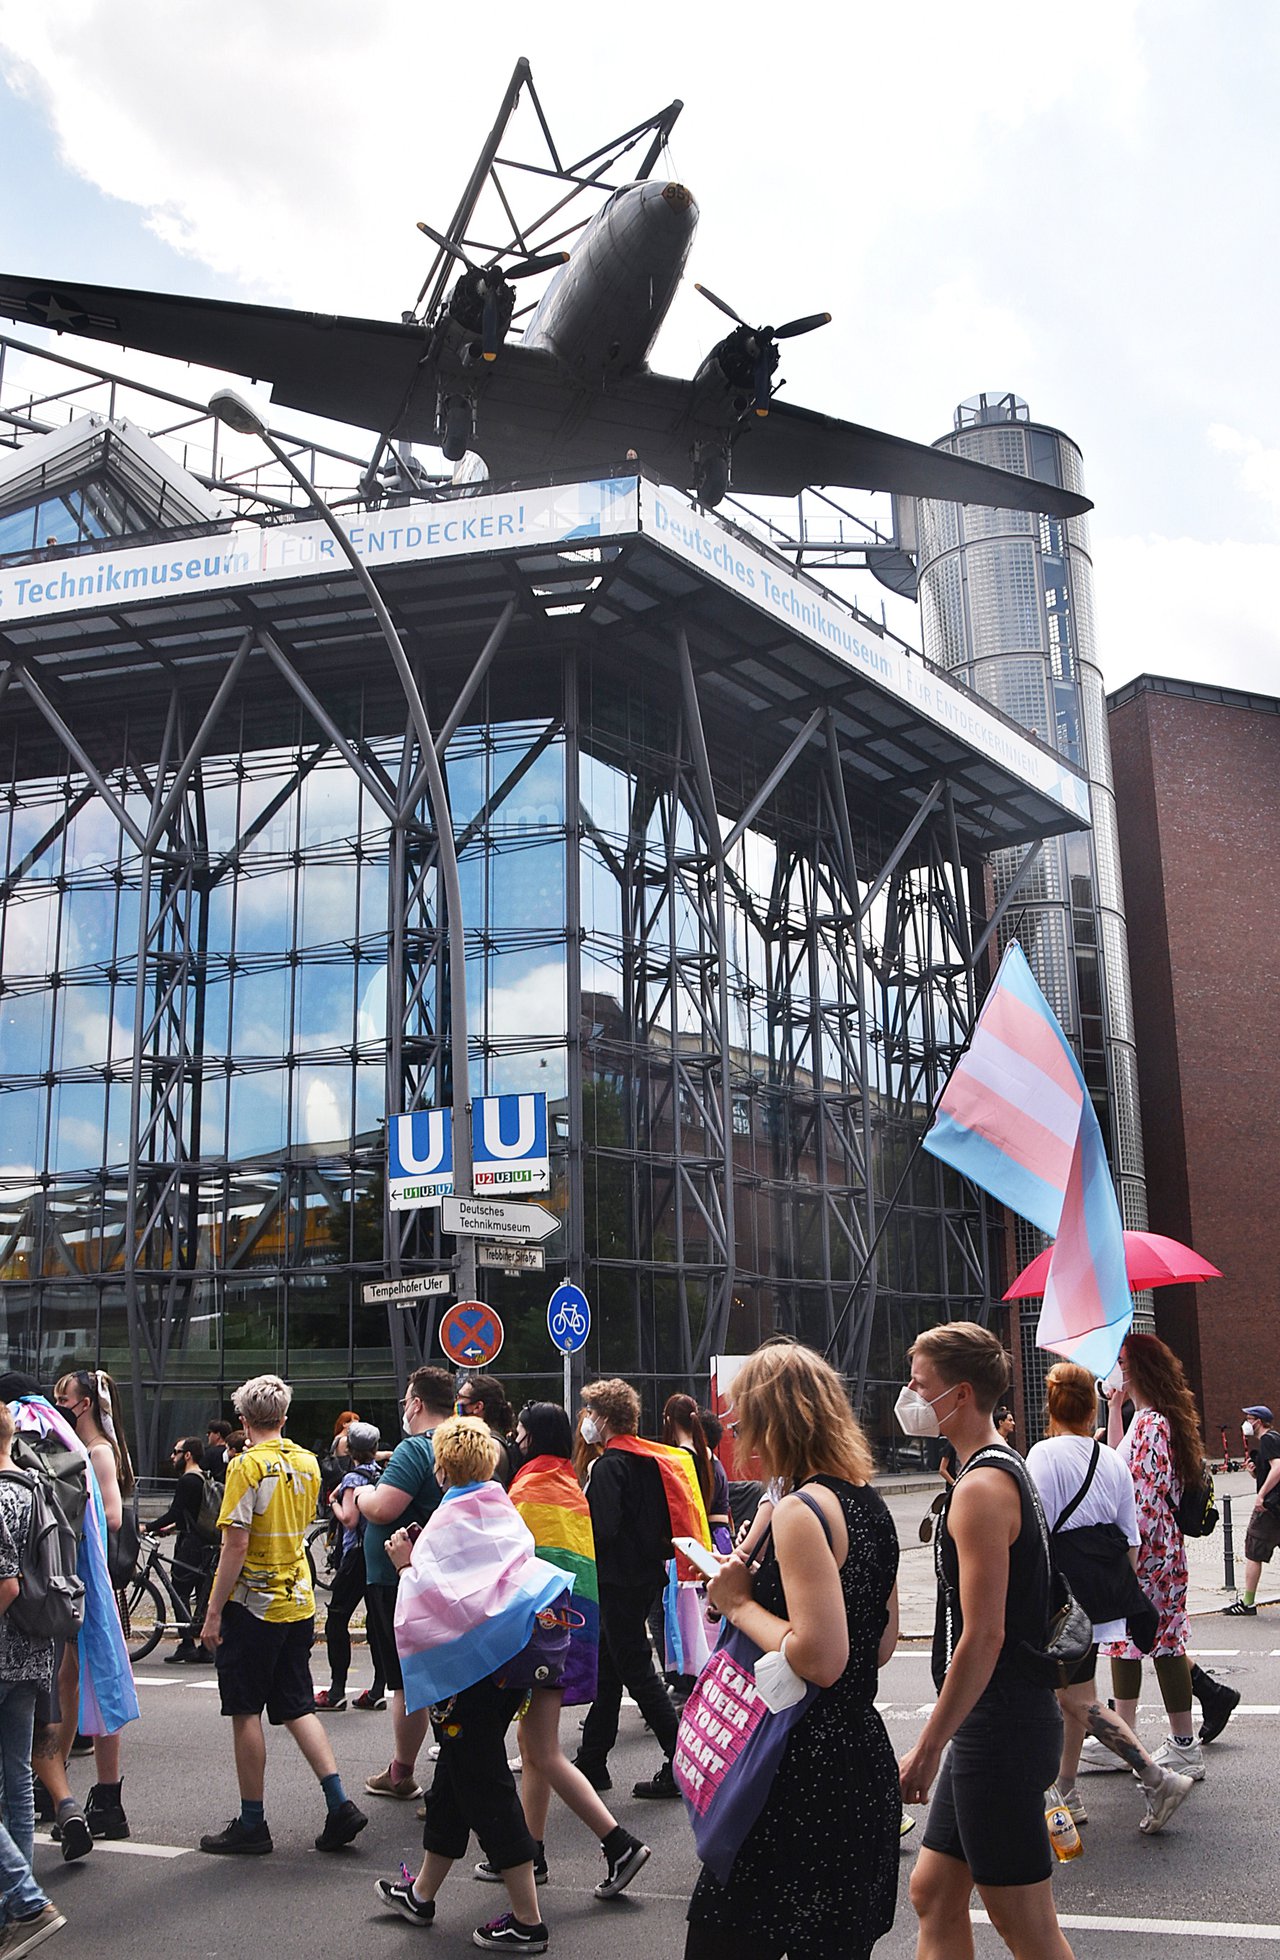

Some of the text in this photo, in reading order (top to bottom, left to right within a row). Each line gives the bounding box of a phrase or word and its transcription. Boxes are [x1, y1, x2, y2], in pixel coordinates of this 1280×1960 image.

[14, 506, 525, 606] Technikmuseum FÜR ENTDECKER!
[654, 501, 756, 588] Deutsches
[760, 568, 893, 679] Technikmuseum
[398, 1110, 443, 1175] U
[483, 1094, 536, 1159] U
[405, 1184, 452, 1198] U1 U3 U7
[477, 1171, 530, 1184] U2 U3 U1
[460, 1203, 505, 1217] Deutsches
[460, 1217, 531, 1233] Technikmuseum
[370, 1279, 443, 1298] Tempelhofer Ufer
[702, 1678, 750, 1731] QUEER
[722, 1666, 759, 1705] CAN
[679, 1721, 725, 1774] HEART
[694, 1702, 734, 1750] YOUR
